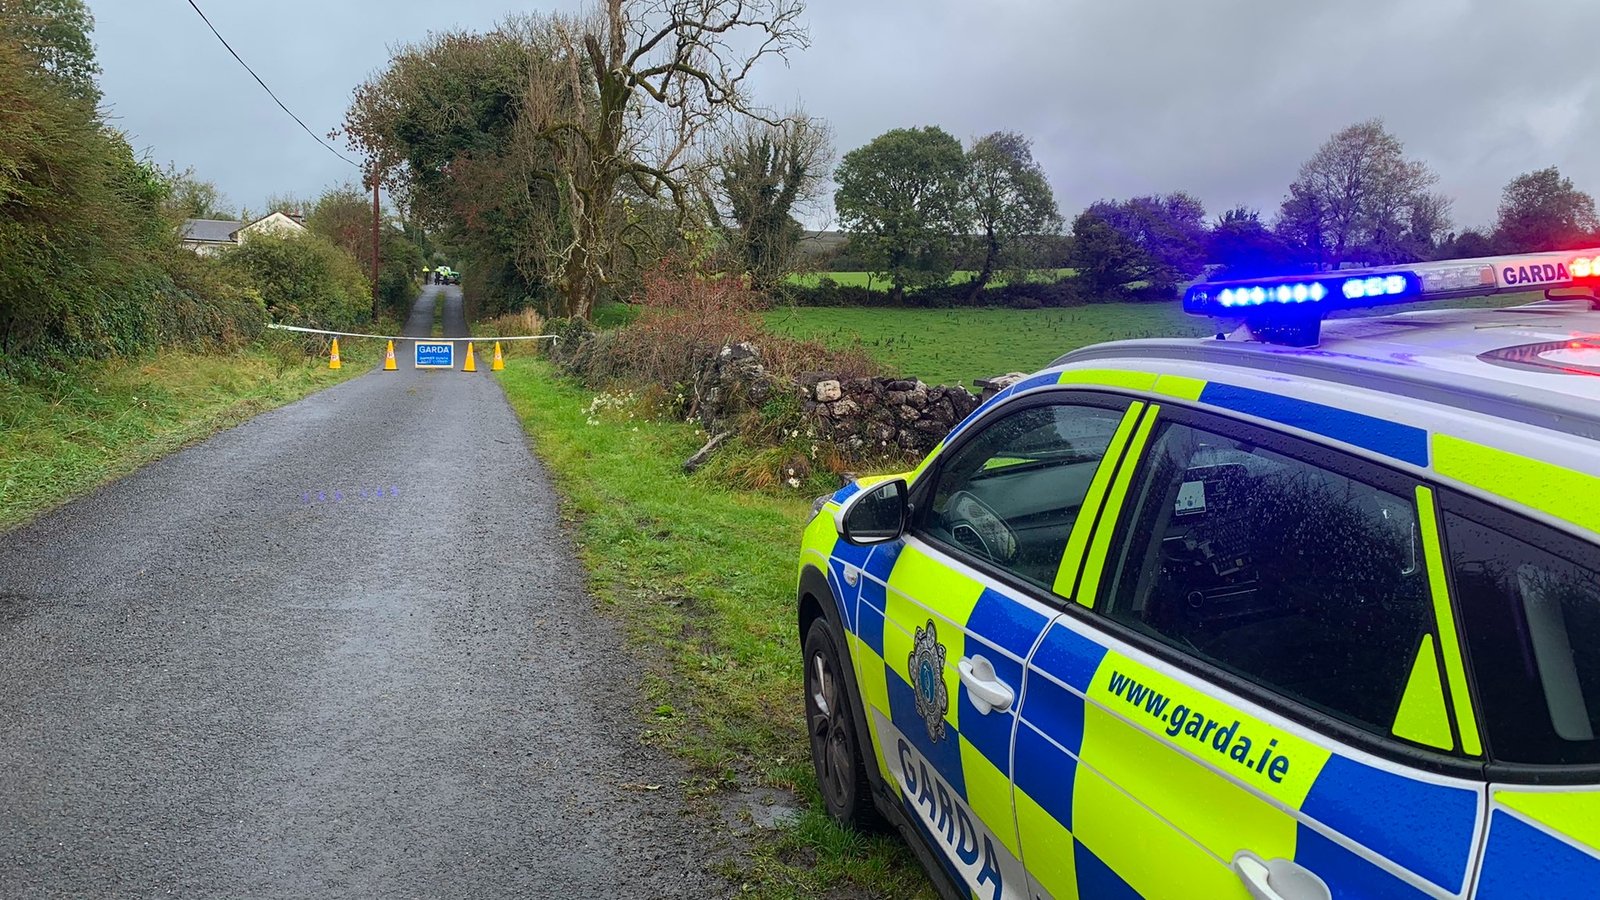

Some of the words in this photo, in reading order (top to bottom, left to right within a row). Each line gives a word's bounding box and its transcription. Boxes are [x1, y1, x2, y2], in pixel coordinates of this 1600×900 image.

[1502, 262, 1570, 285] GARDA
[419, 345, 450, 354] GARDA
[1108, 670, 1290, 784] www.garda.ie
[897, 738, 1003, 900] GARDA
